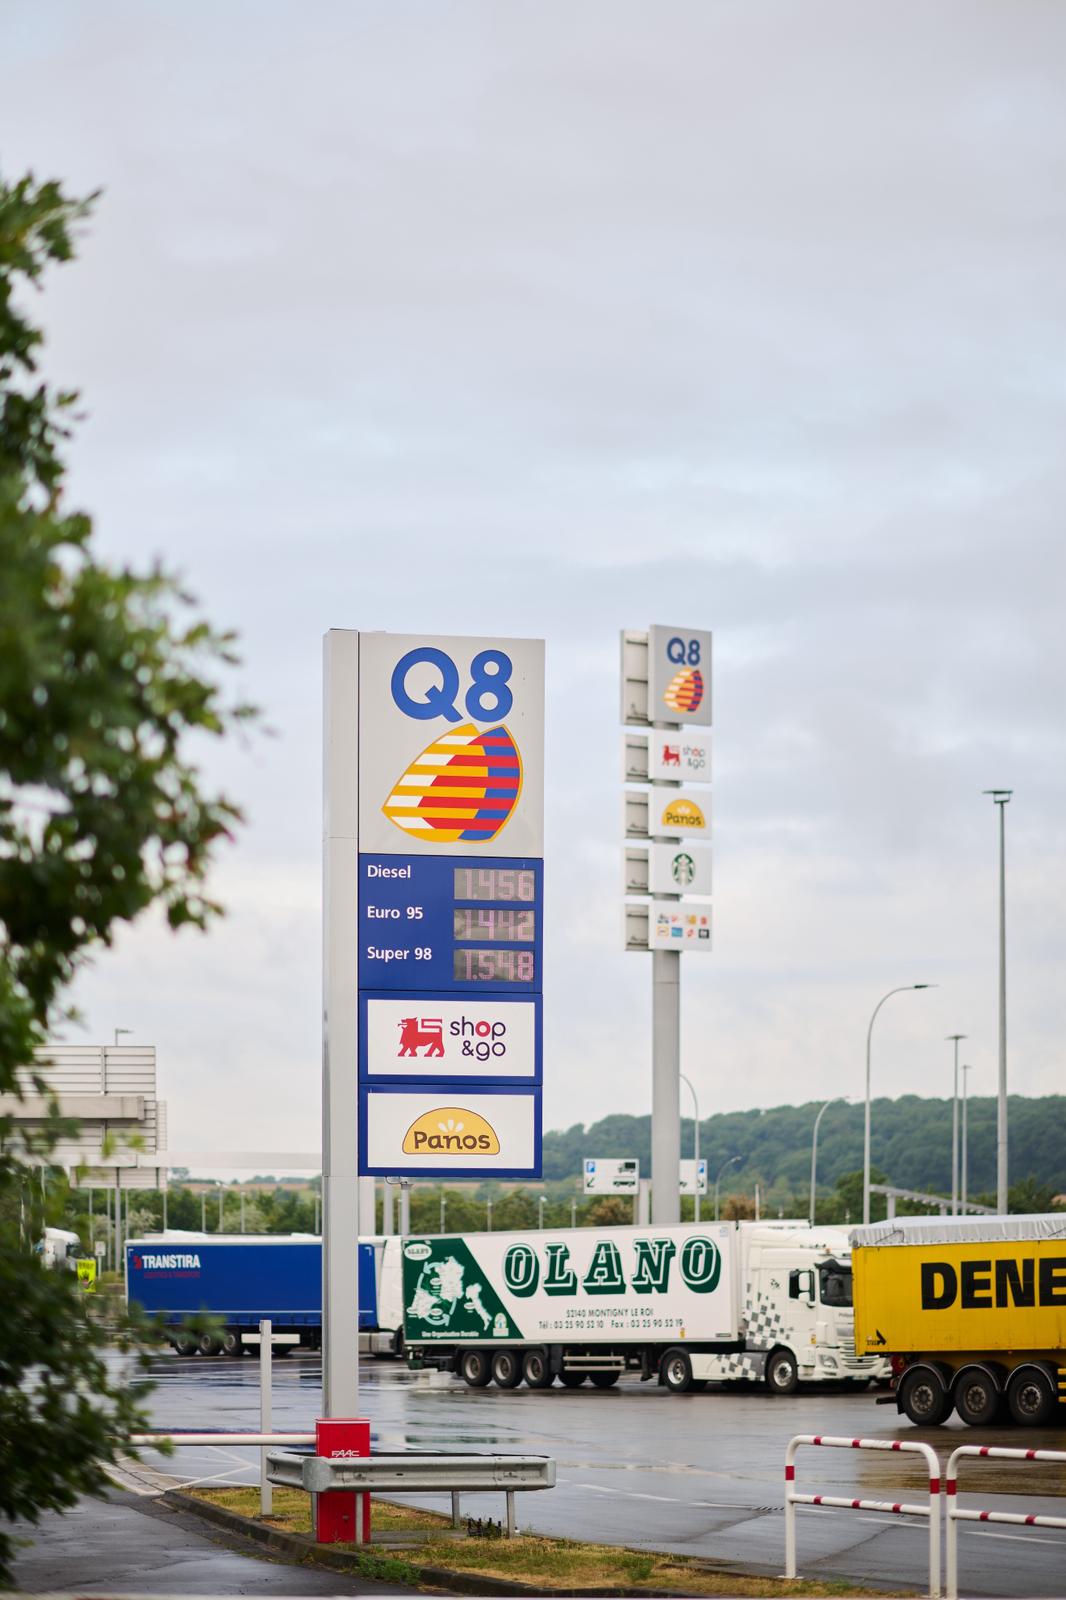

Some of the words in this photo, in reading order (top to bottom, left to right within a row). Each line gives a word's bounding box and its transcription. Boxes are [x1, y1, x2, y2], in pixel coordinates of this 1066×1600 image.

[667, 637, 701, 666] Q8
[390, 647, 514, 723] Q8
[666, 812, 702, 826] Panos
[367, 865, 411, 878] Diesel
[367, 906, 400, 919] Euro
[406, 907, 424, 919] 95
[367, 947, 410, 962] Super
[415, 948, 432, 960] 98
[450, 1016, 506, 1041] shop
[461, 1040, 506, 1061] &go
[414, 1131, 491, 1150] Panos
[142, 1255, 201, 1269] TRANSTIRA
[503, 1236, 721, 1298] OLANO
[588, 1308, 628, 1317] MONTIGNY
[631, 1308, 638, 1316] LE
[554, 1320, 563, 1329] 03
[575, 1320, 584, 1328] 90
[587, 1320, 594, 1328] 52
[611, 1320, 624, 1328] Fax
[631, 1319, 640, 1328] 03
[653, 1319, 662, 1327] 90
[331, 1449, 360, 1457] FAAC
